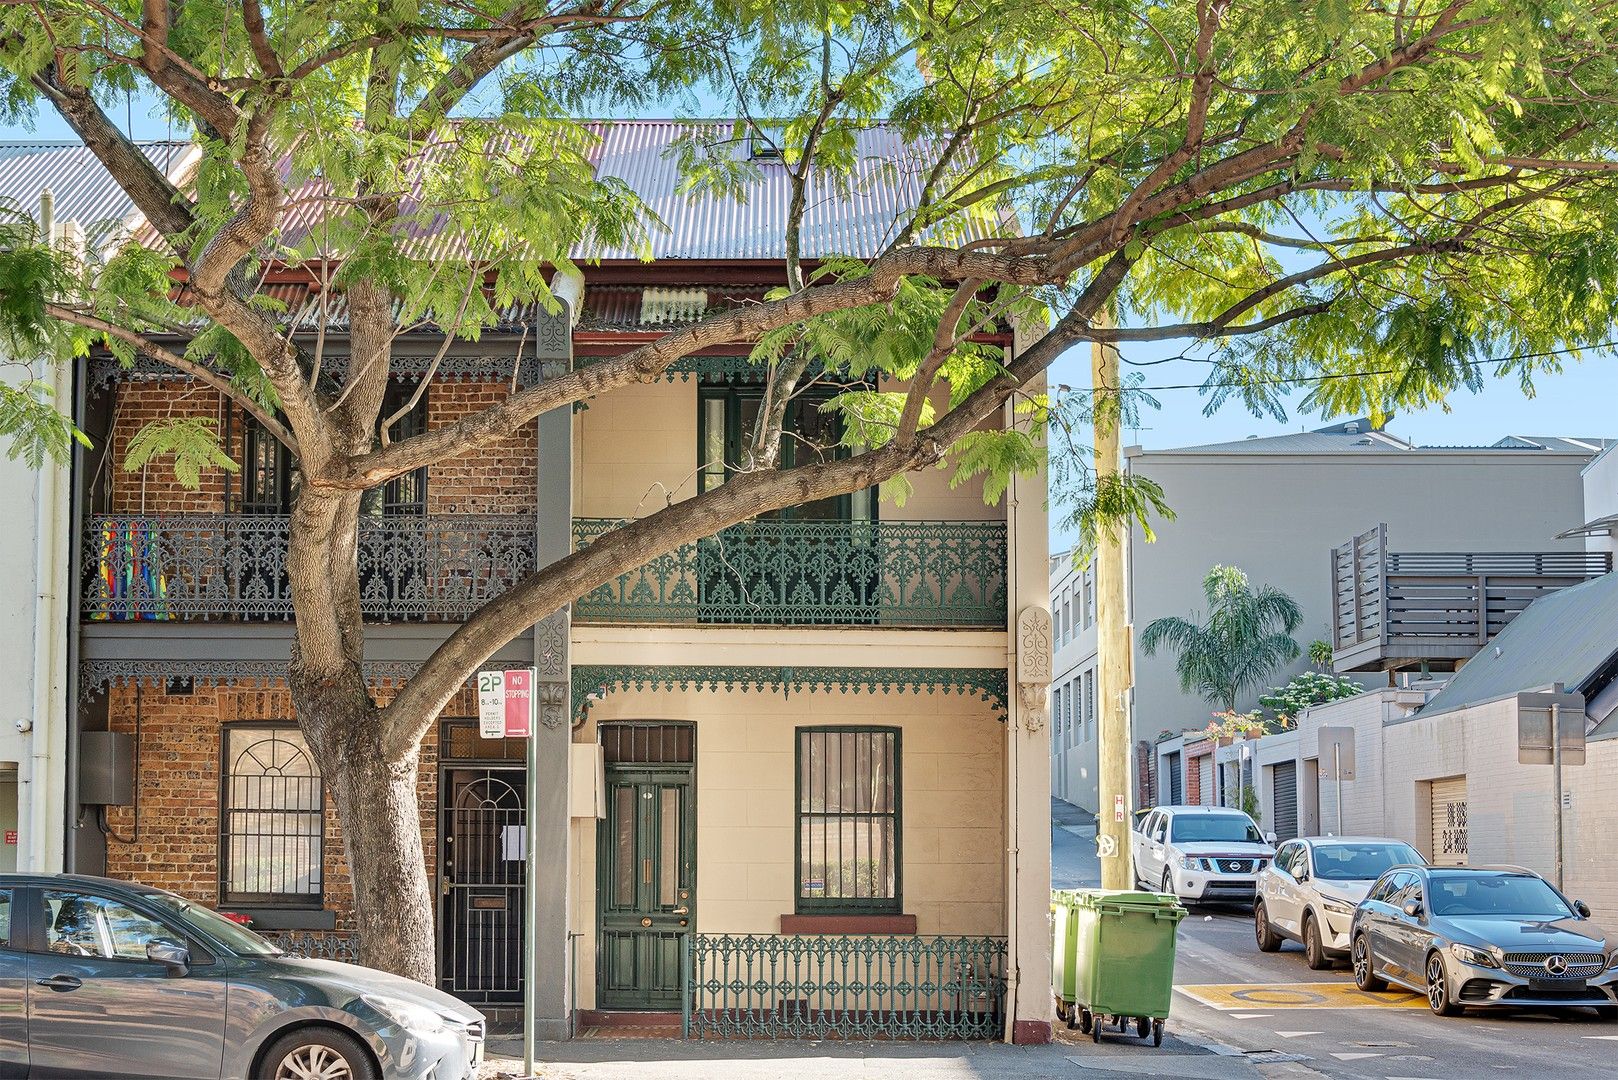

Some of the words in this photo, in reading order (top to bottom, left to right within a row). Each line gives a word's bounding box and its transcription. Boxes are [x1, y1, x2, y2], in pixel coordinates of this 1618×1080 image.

[480, 676, 502, 692] 2P
[512, 676, 523, 685] NO
[505, 689, 530, 699] STOPPING
[1116, 796, 1123, 805] H
[1116, 811, 1123, 821] R
